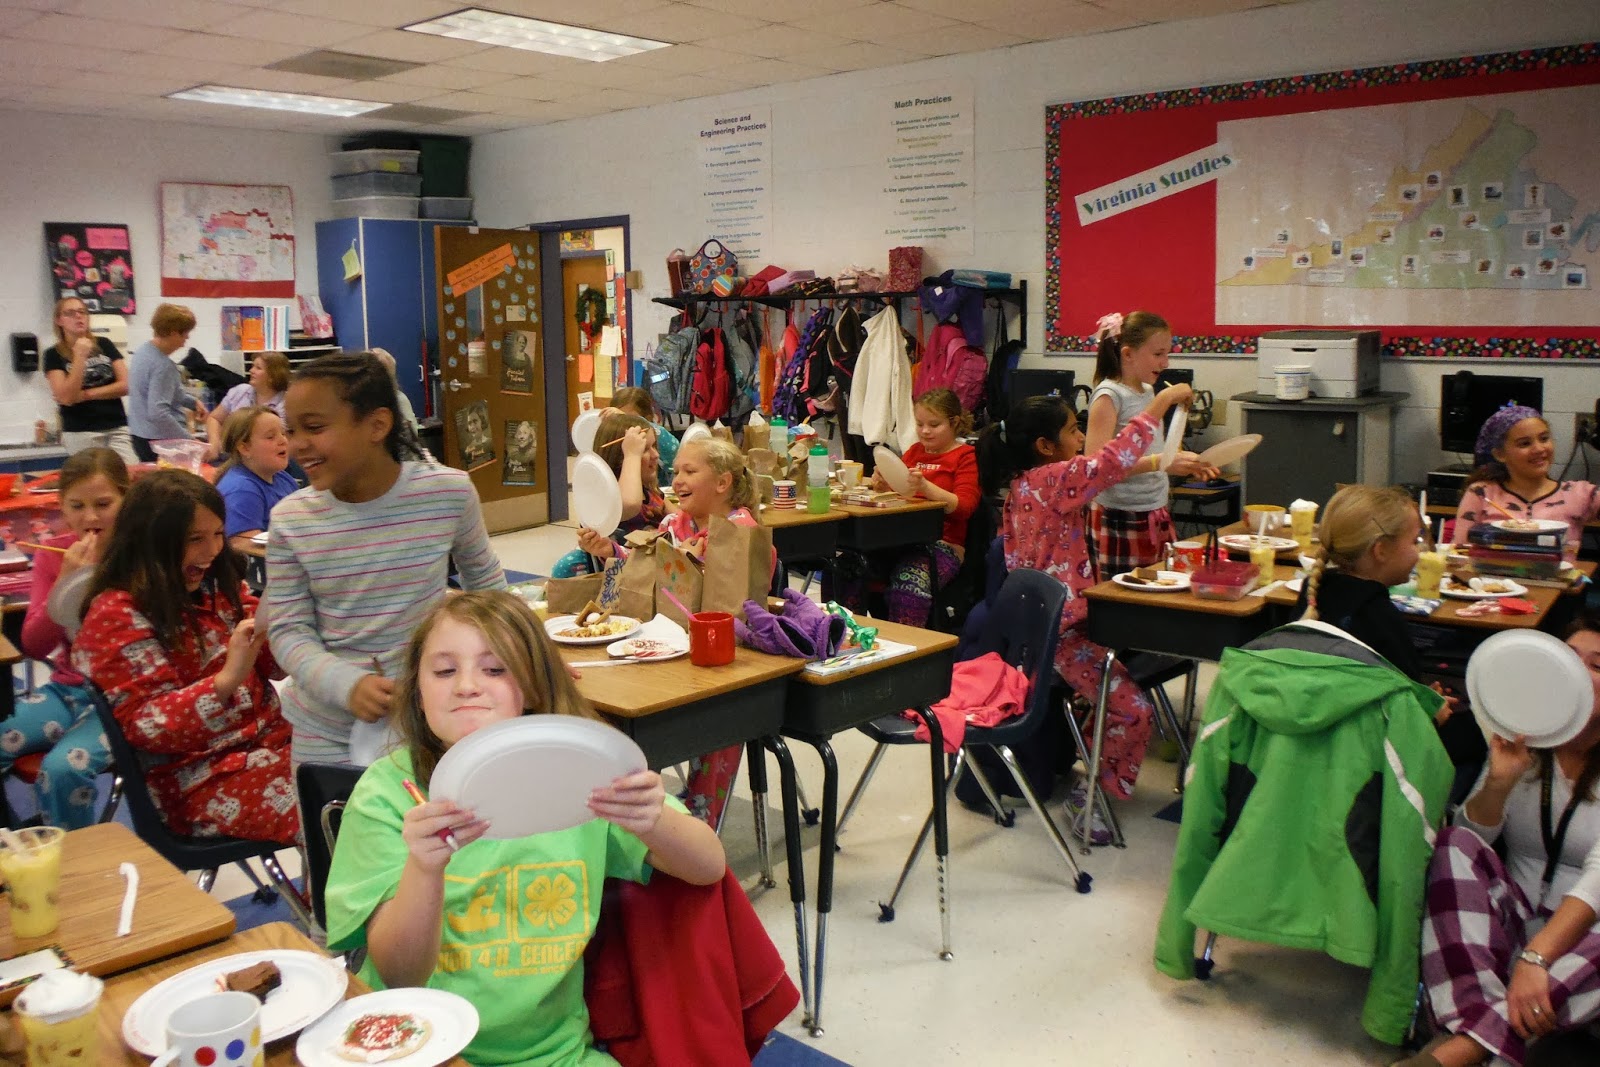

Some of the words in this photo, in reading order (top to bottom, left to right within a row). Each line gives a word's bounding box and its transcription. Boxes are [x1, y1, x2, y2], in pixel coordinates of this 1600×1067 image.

[894, 100, 912, 109] Math
[915, 95, 952, 106] Practices
[714, 117, 738, 126] Science
[739, 114, 752, 122] and
[700, 127, 736, 138] Engineering
[736, 122, 767, 132] Practices
[1082, 180, 1157, 216] Virginia
[1159, 153, 1232, 189] Studies
[916, 462, 941, 470] SWEET
